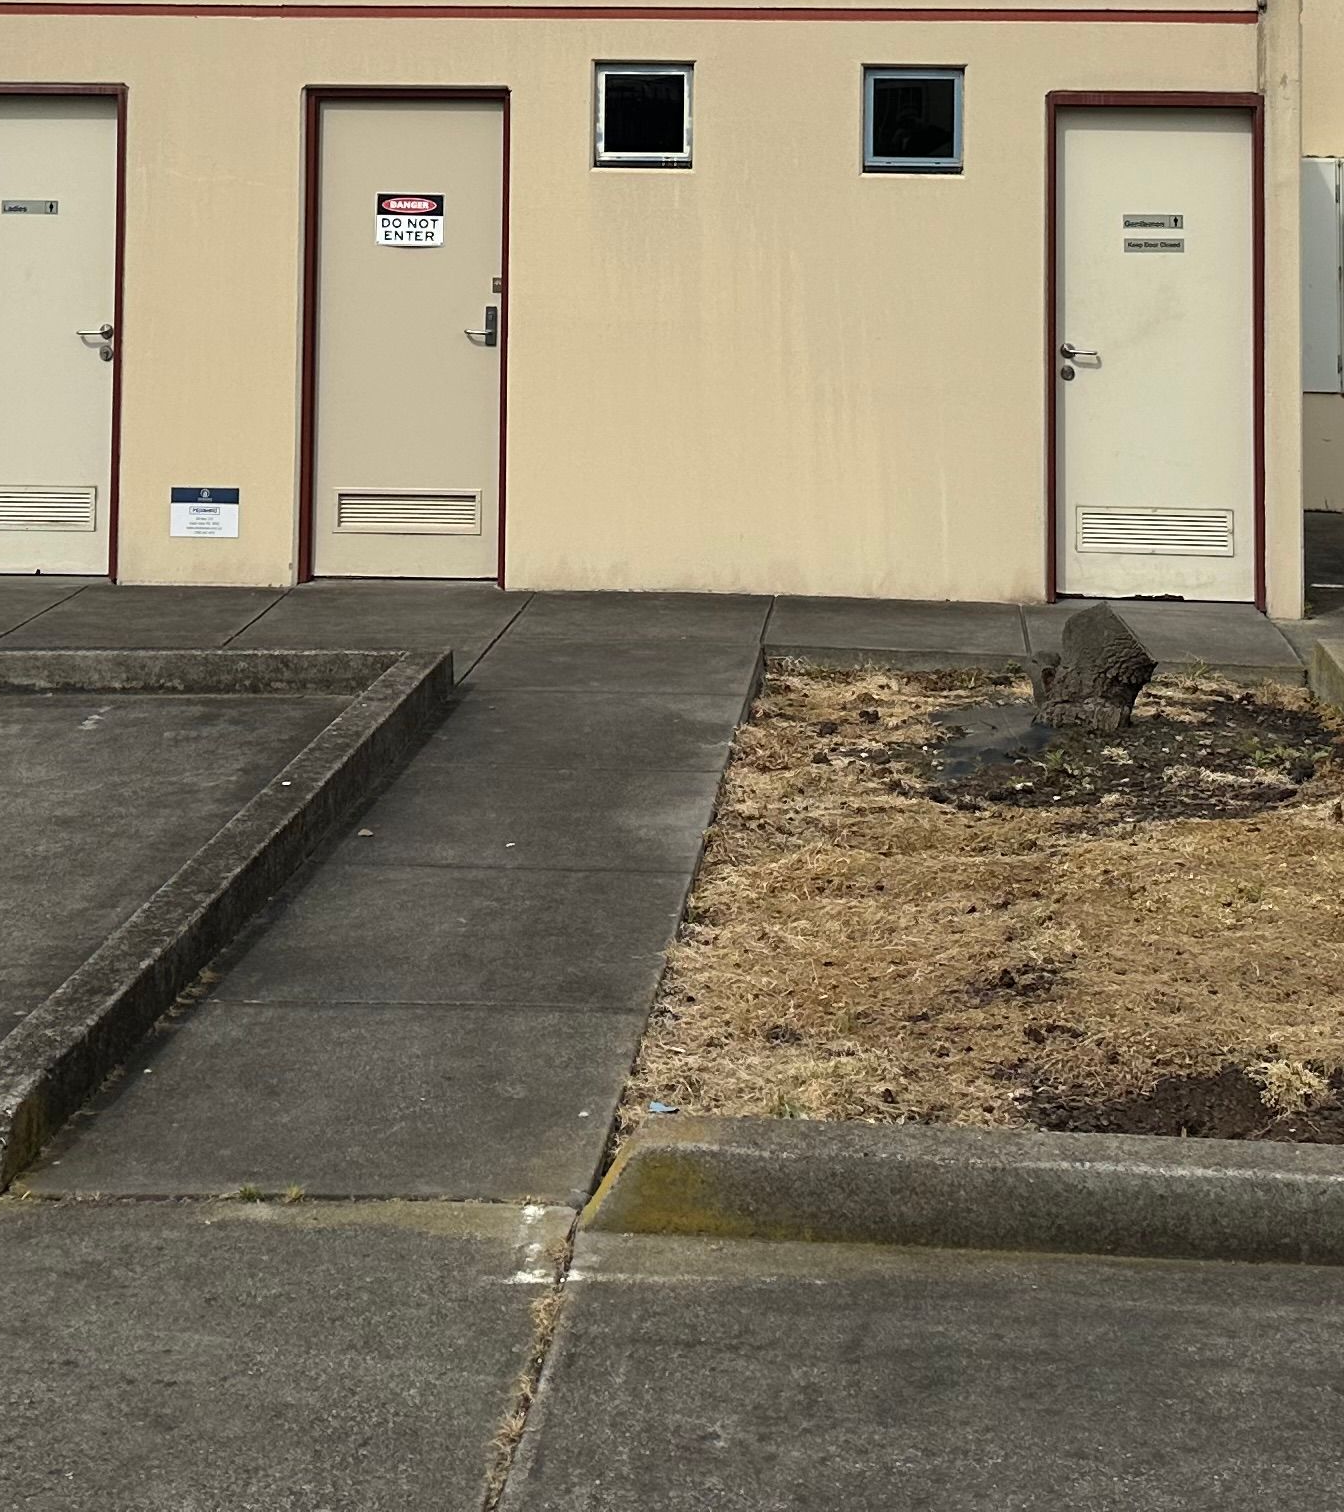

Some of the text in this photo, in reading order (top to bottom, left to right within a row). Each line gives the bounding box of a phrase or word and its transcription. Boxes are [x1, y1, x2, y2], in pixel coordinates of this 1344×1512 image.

[389, 200, 430, 210] DANGER
[381, 217, 439, 230] DO NOT
[384, 230, 435, 242] ENTER
